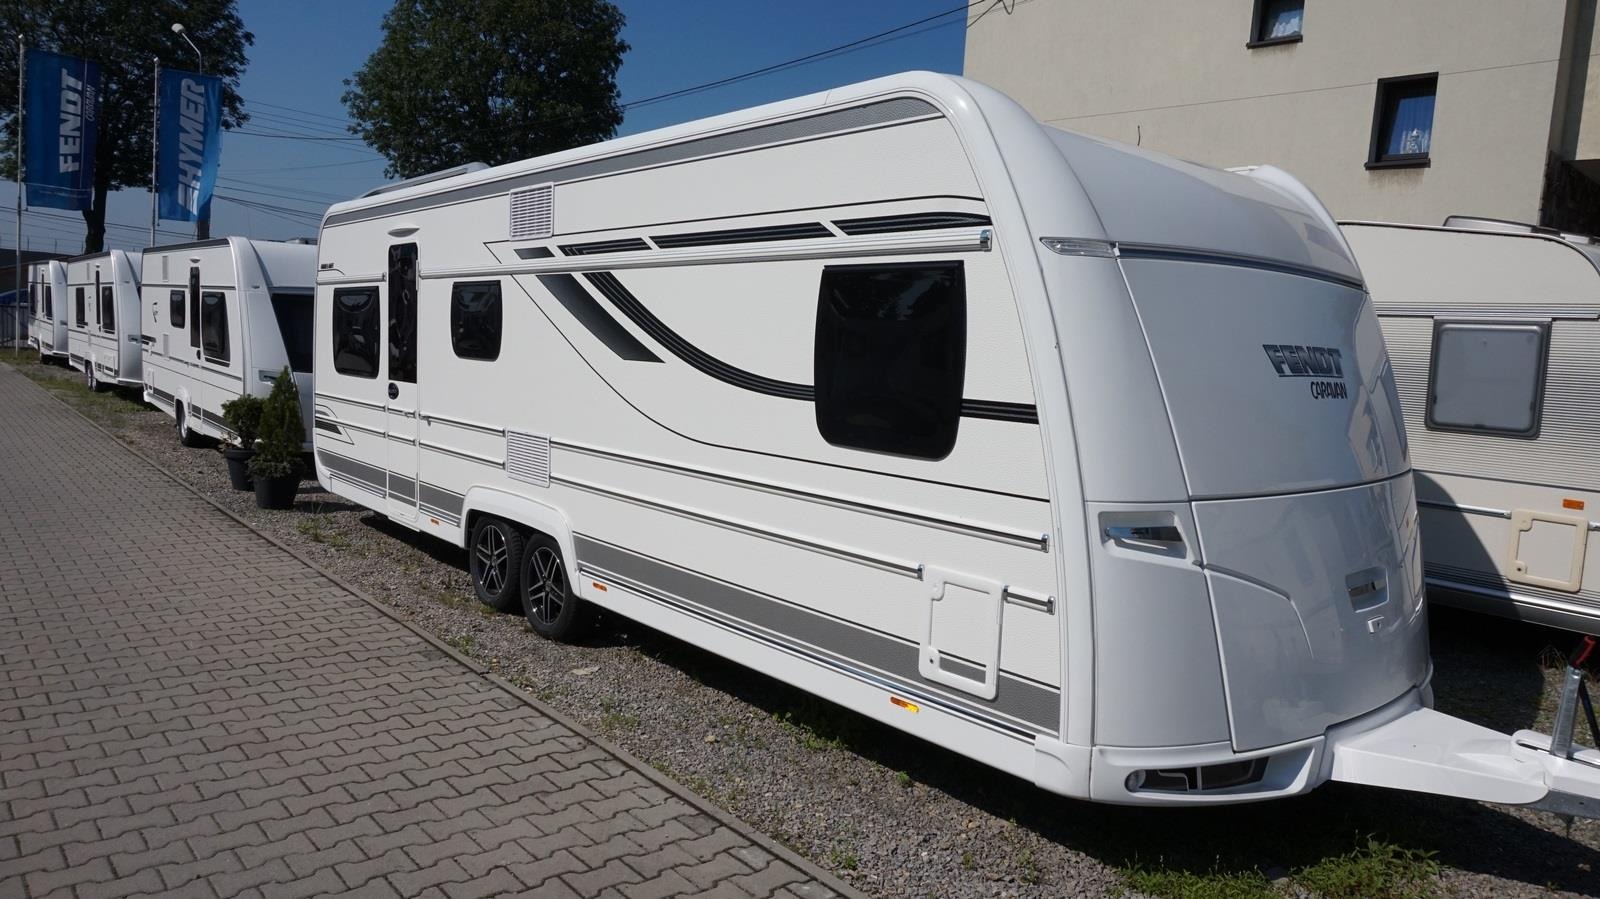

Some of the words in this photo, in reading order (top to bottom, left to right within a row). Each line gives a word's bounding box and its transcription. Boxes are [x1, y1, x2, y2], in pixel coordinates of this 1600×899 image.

[59, 67, 84, 174] FENDT
[1262, 344, 1344, 376] FENDT
[1310, 381, 1348, 400] CARAVAN
